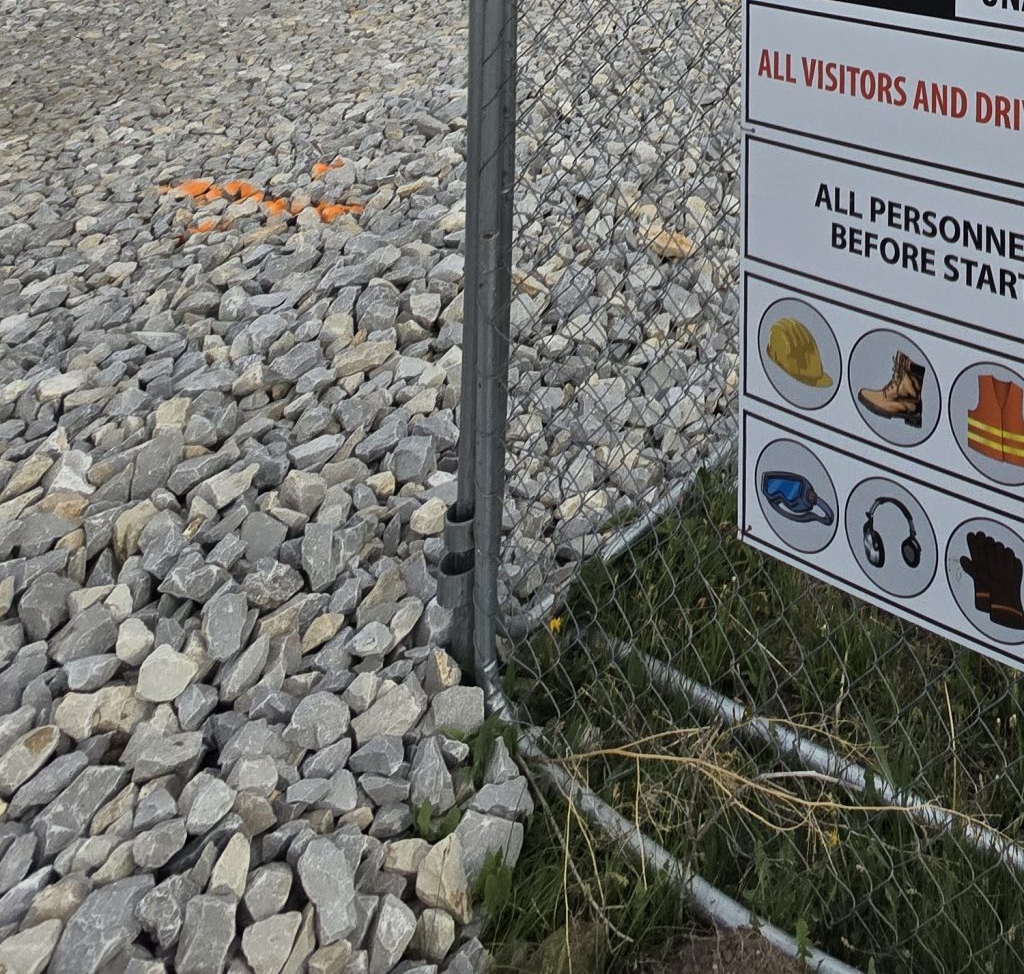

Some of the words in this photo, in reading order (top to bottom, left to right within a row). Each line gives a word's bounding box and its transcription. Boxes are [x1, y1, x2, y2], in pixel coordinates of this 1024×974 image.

[759, 50, 796, 82] ALL
[802, 58, 906, 106] VISITORS
[913, 81, 968, 119] AND
[815, 183, 862, 219] ALL
[832, 222, 935, 276] BEFORE
